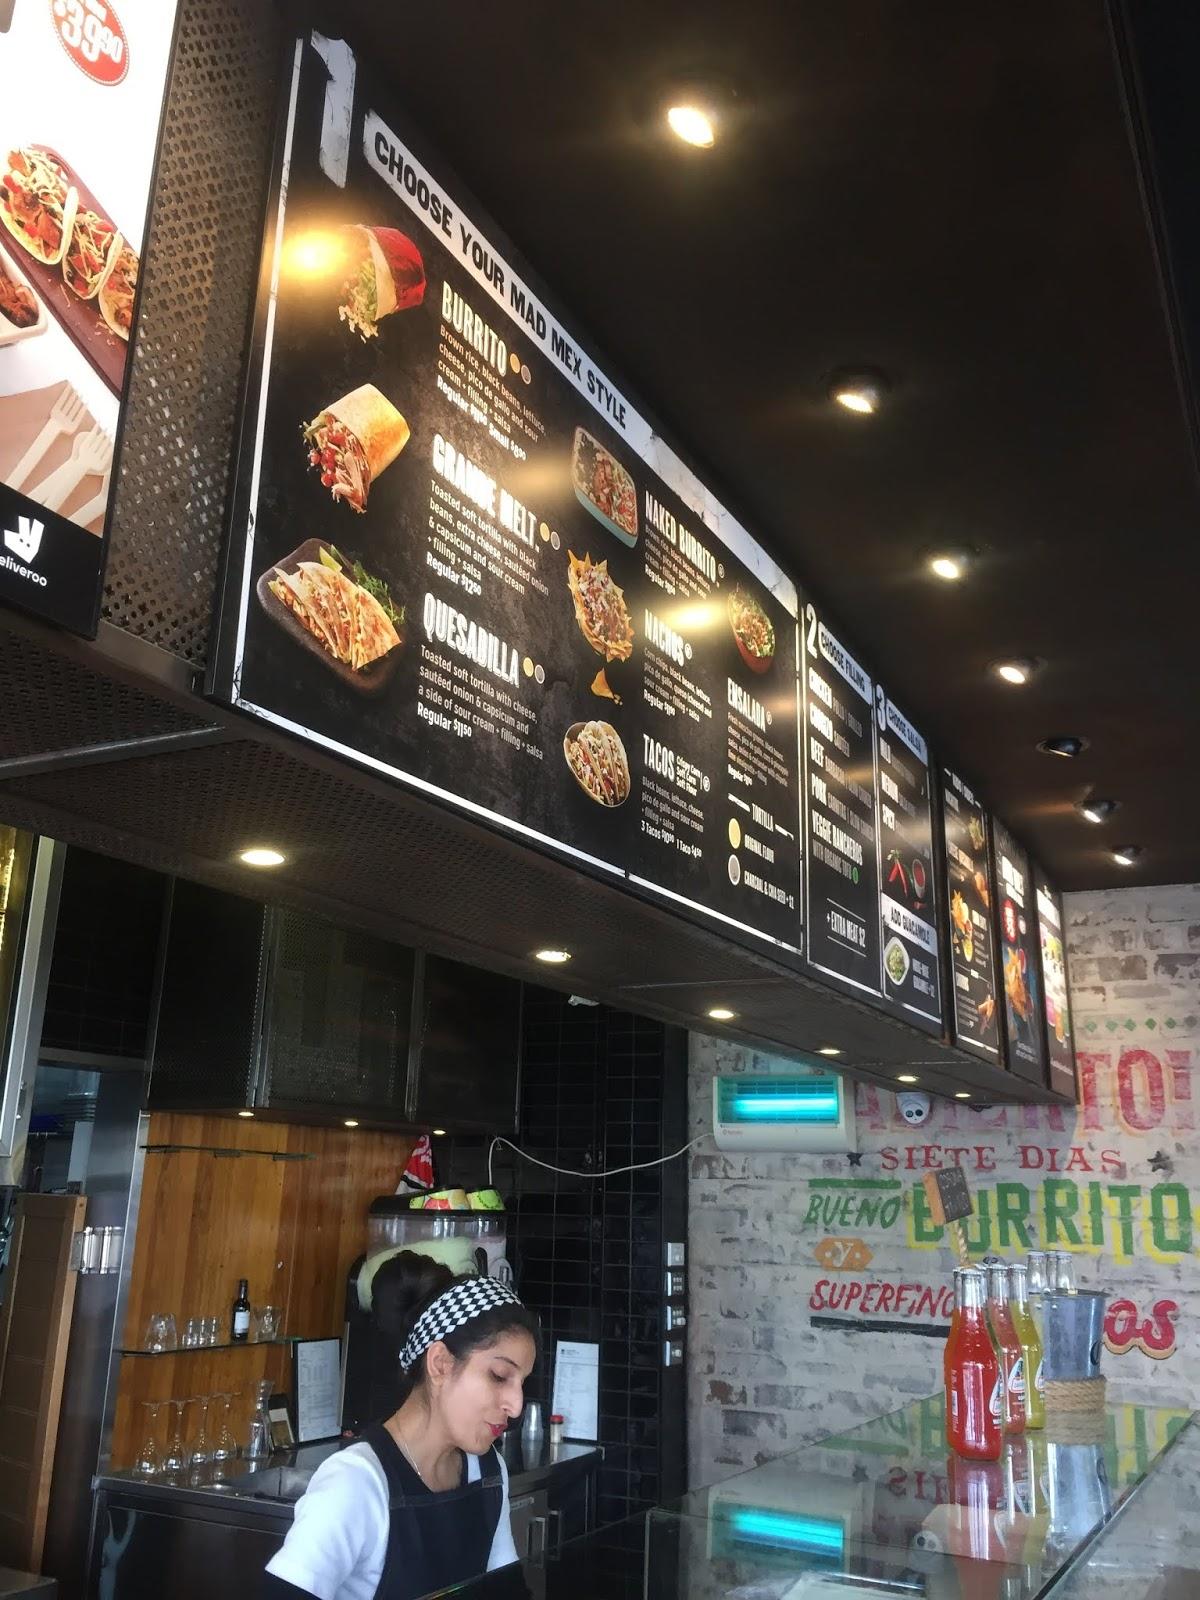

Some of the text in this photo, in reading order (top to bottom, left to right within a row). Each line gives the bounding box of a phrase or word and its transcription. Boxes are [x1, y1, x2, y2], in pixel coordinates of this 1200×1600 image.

[311, 29, 357, 188] 1
[375, 133, 626, 429] CHOOSE YOUR MAD MEX STYLE
[443, 284, 506, 375] BURRITO
[441, 325, 464, 355] Brown
[466, 351, 481, 373] rice,
[482, 366, 500, 391] black
[437, 376, 470, 414] Regular
[489, 423, 509, 449] Small
[438, 361, 461, 388] cream
[494, 412, 511, 433] salsa
[439, 344, 467, 377] cheese,
[468, 371, 484, 390] pico
[484, 386, 493, 400] de
[511, 412, 524, 429] and
[525, 425, 538, 442] sour
[432, 480, 536, 570] Toasted soft tortilla with black
[646, 492, 677, 545] NAKED
[427, 552, 460, 584] Regular
[430, 497, 455, 527] beans,
[457, 521, 476, 541] extra
[531, 577, 549, 596] onion
[433, 537, 482, 581] filling salsa
[437, 524, 472, 556] capsicum
[473, 551, 487, 567] and
[488, 562, 504, 578] sour
[504, 574, 525, 594] cream
[424, 595, 519, 685] QUESADILLA
[645, 611, 684, 665] NACHOS
[806, 603, 818, 659] 2
[422, 645, 537, 723] Toasted soft tortilla with cheese,
[822, 633, 865, 692] CHOOSE FILLING
[418, 702, 452, 730] Regular
[418, 685, 543, 760] a side of sour cream filling salsa
[453, 685, 475, 704] onion
[475, 696, 482, 708] &
[483, 702, 515, 726] capsicum
[516, 721, 529, 735] and
[728, 679, 765, 731] ENSALADA
[876, 684, 886, 731] 3
[644, 735, 675, 781] TACOS
[677, 767, 686, 779] Soft
[677, 777, 686, 790] Soft
[812, 774, 827, 805] PORK
[641, 819, 645, 832] 3
[646, 823, 661, 839] Tacos
[680, 840, 692, 855] Taco
[753, 804, 773, 831] TORTILLA
[812, 810, 832, 844] VEGGIE
[831, 912, 846, 937] EXTRA
[847, 920, 858, 943] MEAT
[891, 908, 901, 927] ADD
[881, 1145, 1122, 1174] SIETE DIAS
[802, 1193, 902, 1230] BUENO
